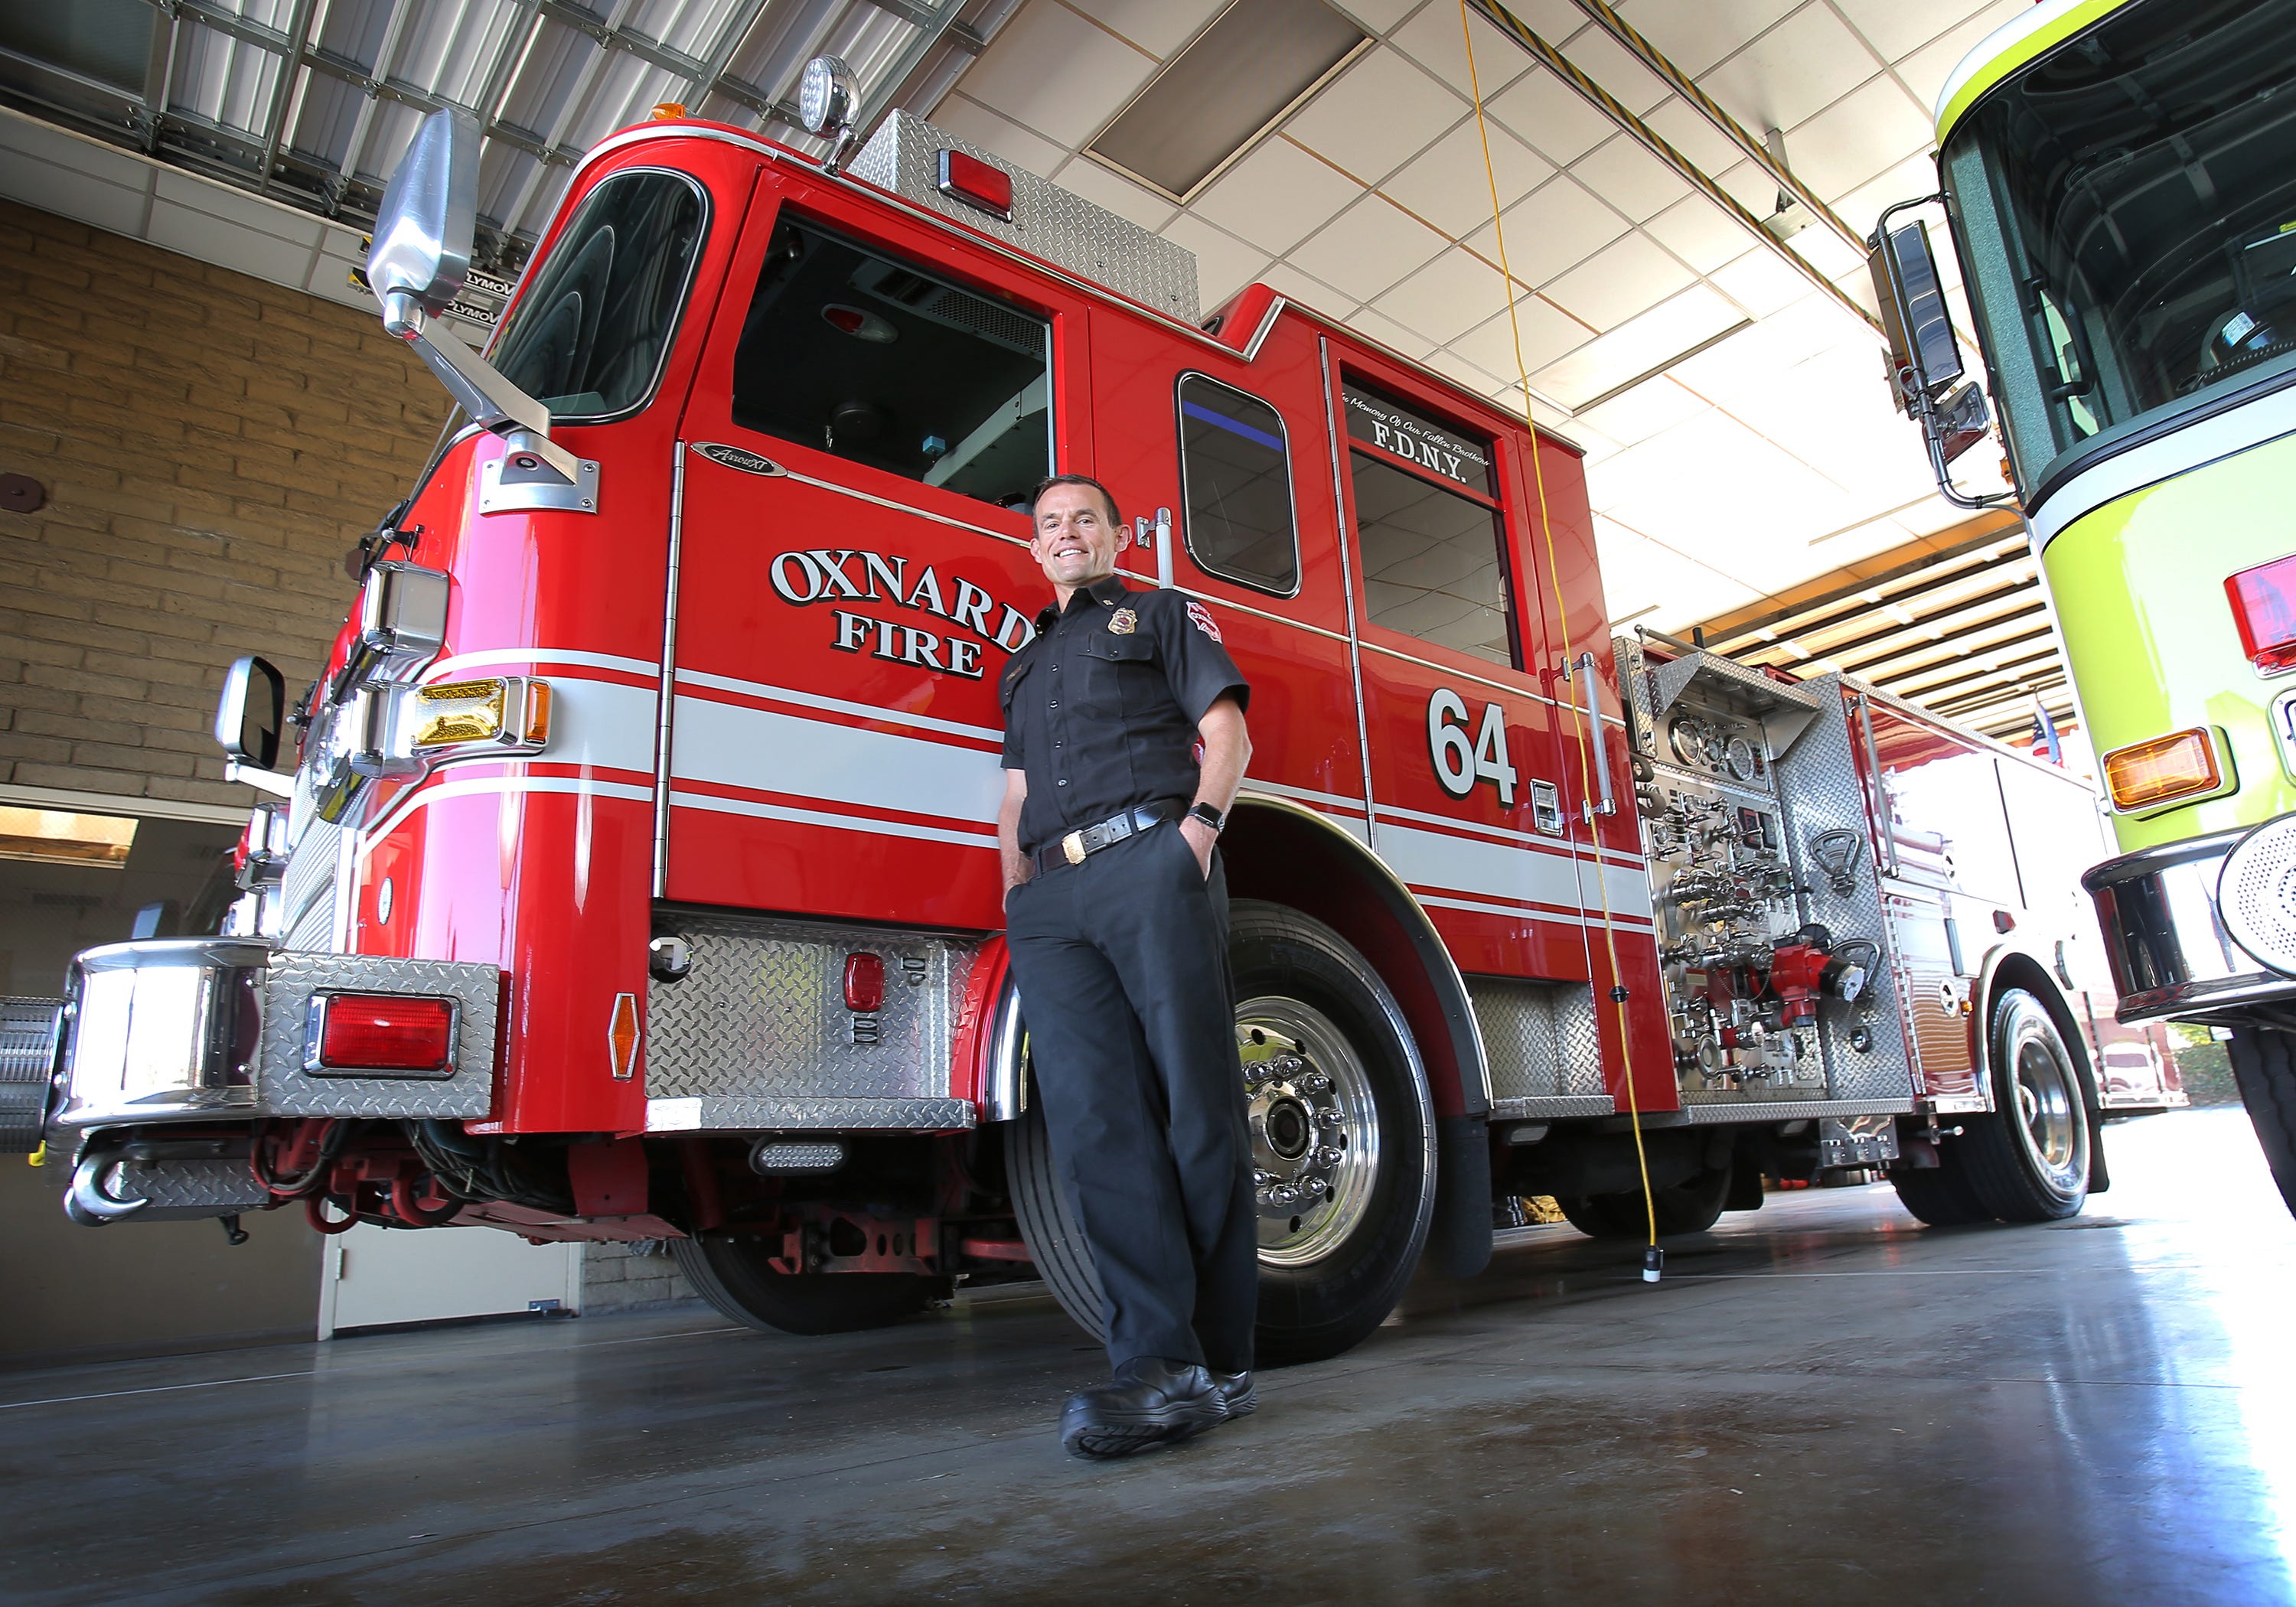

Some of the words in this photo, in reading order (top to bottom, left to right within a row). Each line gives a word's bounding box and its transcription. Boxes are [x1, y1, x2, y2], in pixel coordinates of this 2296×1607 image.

[466, 271, 515, 295] LYMOV
[1350, 397, 1388, 421] Memory
[1389, 415, 1401, 427] Of
[1403, 421, 1421, 435] Our
[1422, 430, 1451, 448] Fallen
[1452, 444, 1490, 466] Brothers
[1371, 419, 1466, 484] F.D.N.Y.
[770, 549, 1037, 656] OXNARD
[831, 609, 984, 680] FIRE
[1427, 687, 1518, 808] 64
